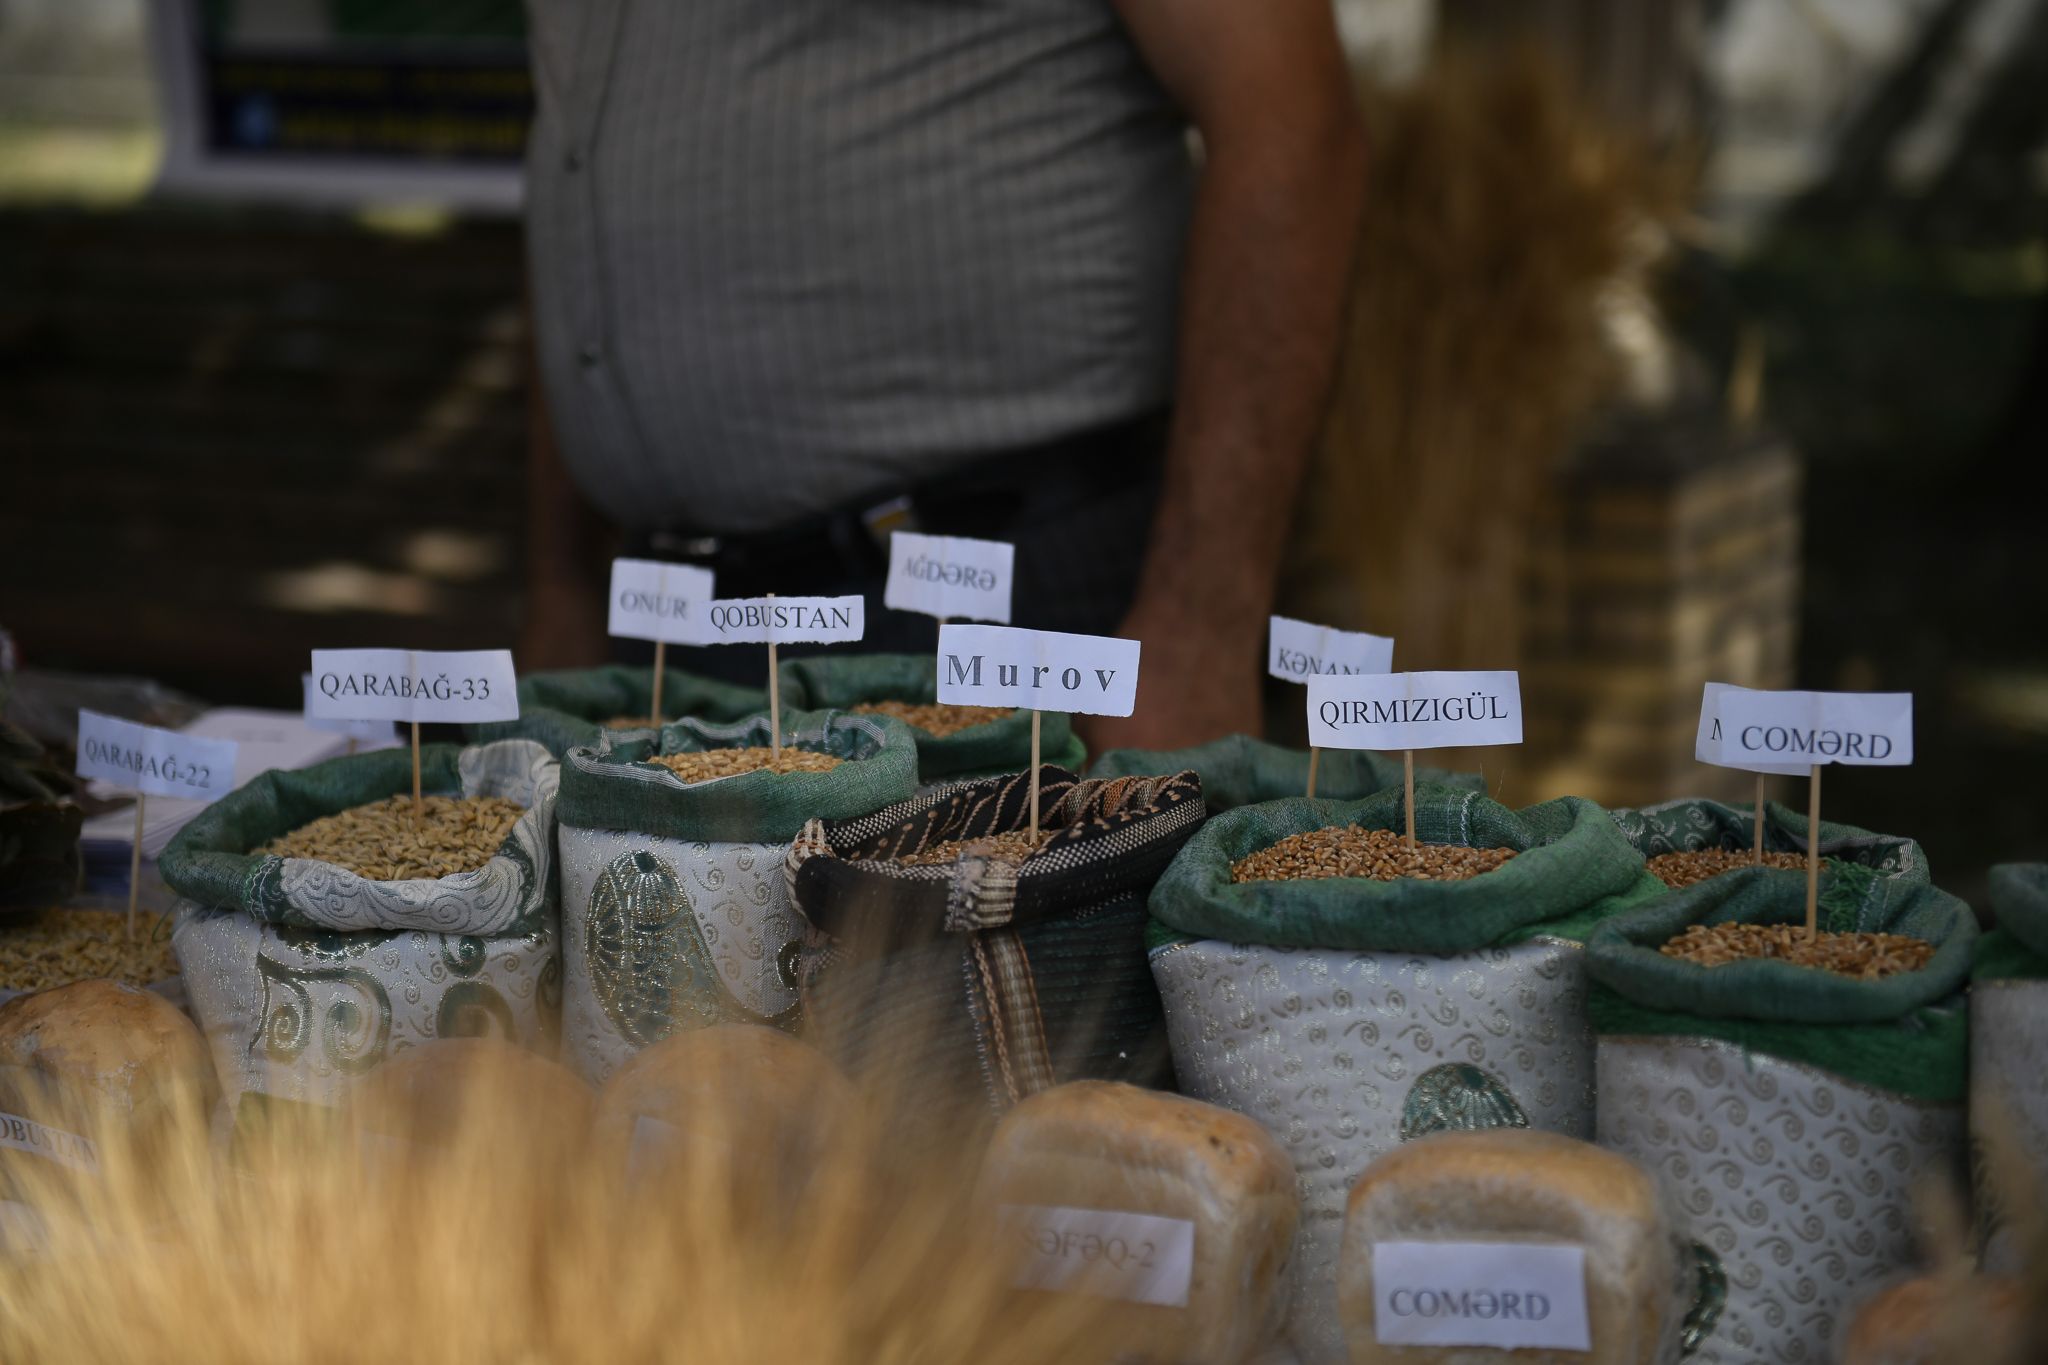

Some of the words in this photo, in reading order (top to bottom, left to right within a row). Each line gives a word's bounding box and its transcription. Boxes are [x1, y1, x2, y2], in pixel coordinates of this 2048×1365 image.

[903, 555, 997, 592] AĞDƏRƏ
[619, 588, 689, 620] ONUR
[710, 606, 852, 633] QOBUSTAN
[319, 672, 490, 700] QARABAĞ-33
[945, 655, 1117, 692] Murov
[1319, 692, 1509, 730] QIRMIZIGÜL
[1741, 726, 1893, 760] COMƏRD
[85, 736, 210, 788] QARABAĞ-22
[1388, 1287, 1550, 1321] COMƏRD
